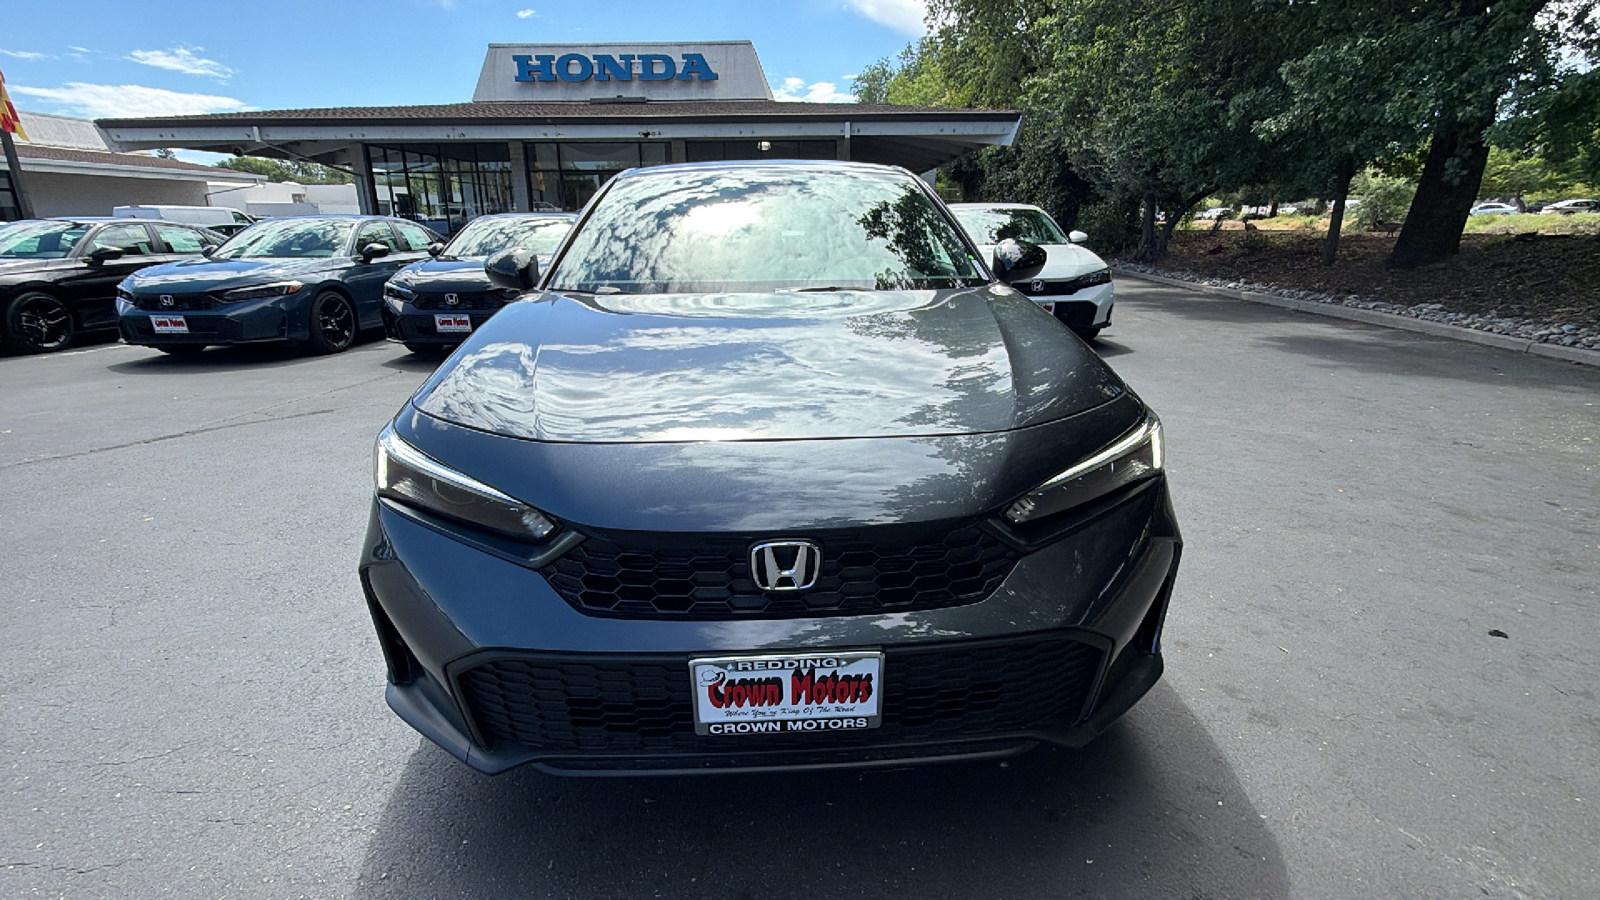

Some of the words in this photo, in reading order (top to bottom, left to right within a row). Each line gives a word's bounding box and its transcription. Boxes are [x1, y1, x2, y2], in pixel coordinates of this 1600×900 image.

[512, 53, 719, 83] HONDA
[737, 658, 837, 671] REDDING
[708, 673, 783, 708] Crown
[791, 669, 872, 706] Motors
[780, 708, 800, 716] King
[834, 705, 856, 713] Road
[709, 721, 781, 734] CROWN
[787, 718, 868, 732] MOTORS
